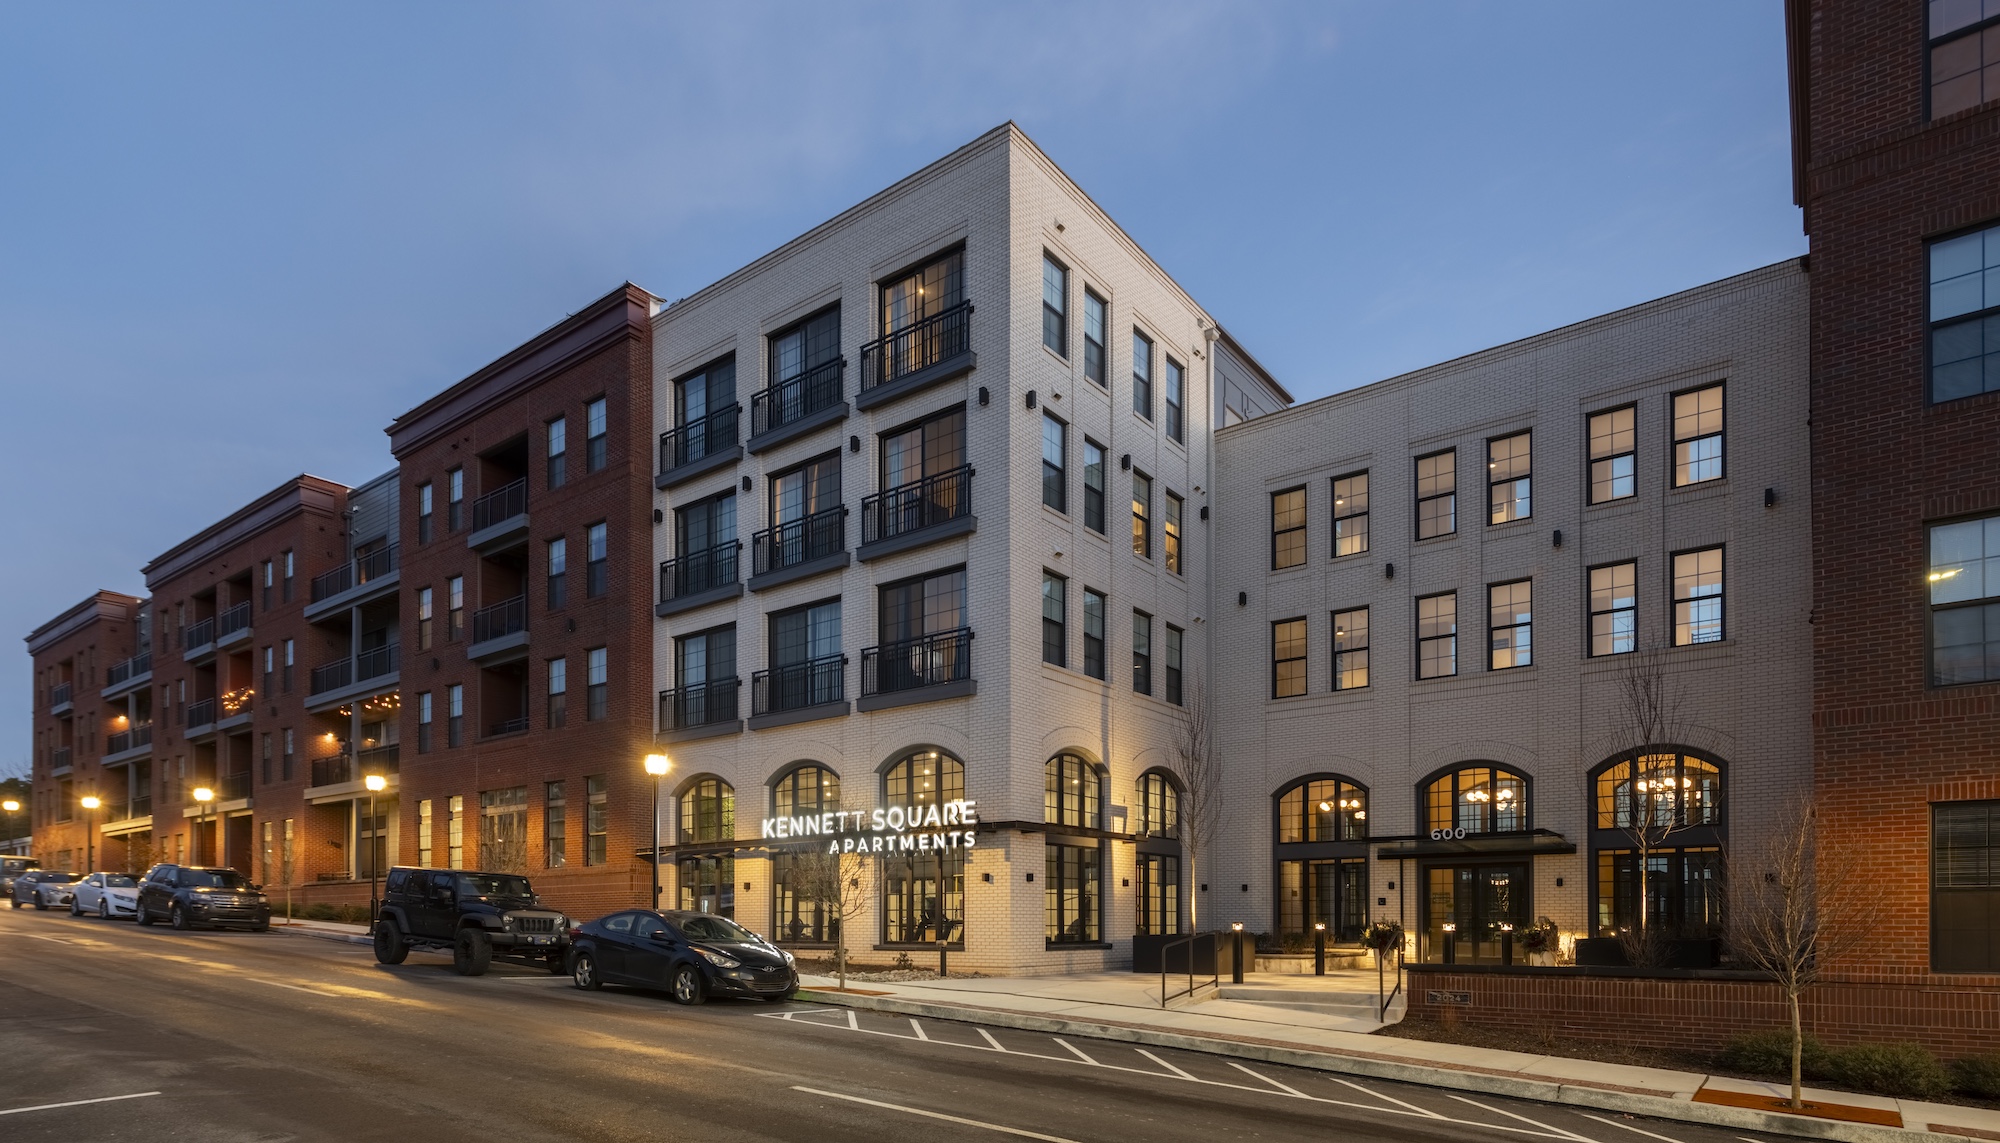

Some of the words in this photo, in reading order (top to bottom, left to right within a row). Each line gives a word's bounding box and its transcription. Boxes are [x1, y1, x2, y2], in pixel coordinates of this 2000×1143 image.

[762, 811, 866, 839] KENNETT
[871, 801, 977, 831] SQUARE
[829, 831, 976, 854] APARTMENTS
[1430, 827, 1466, 840] 600
[1436, 994, 1461, 1002] 2024
